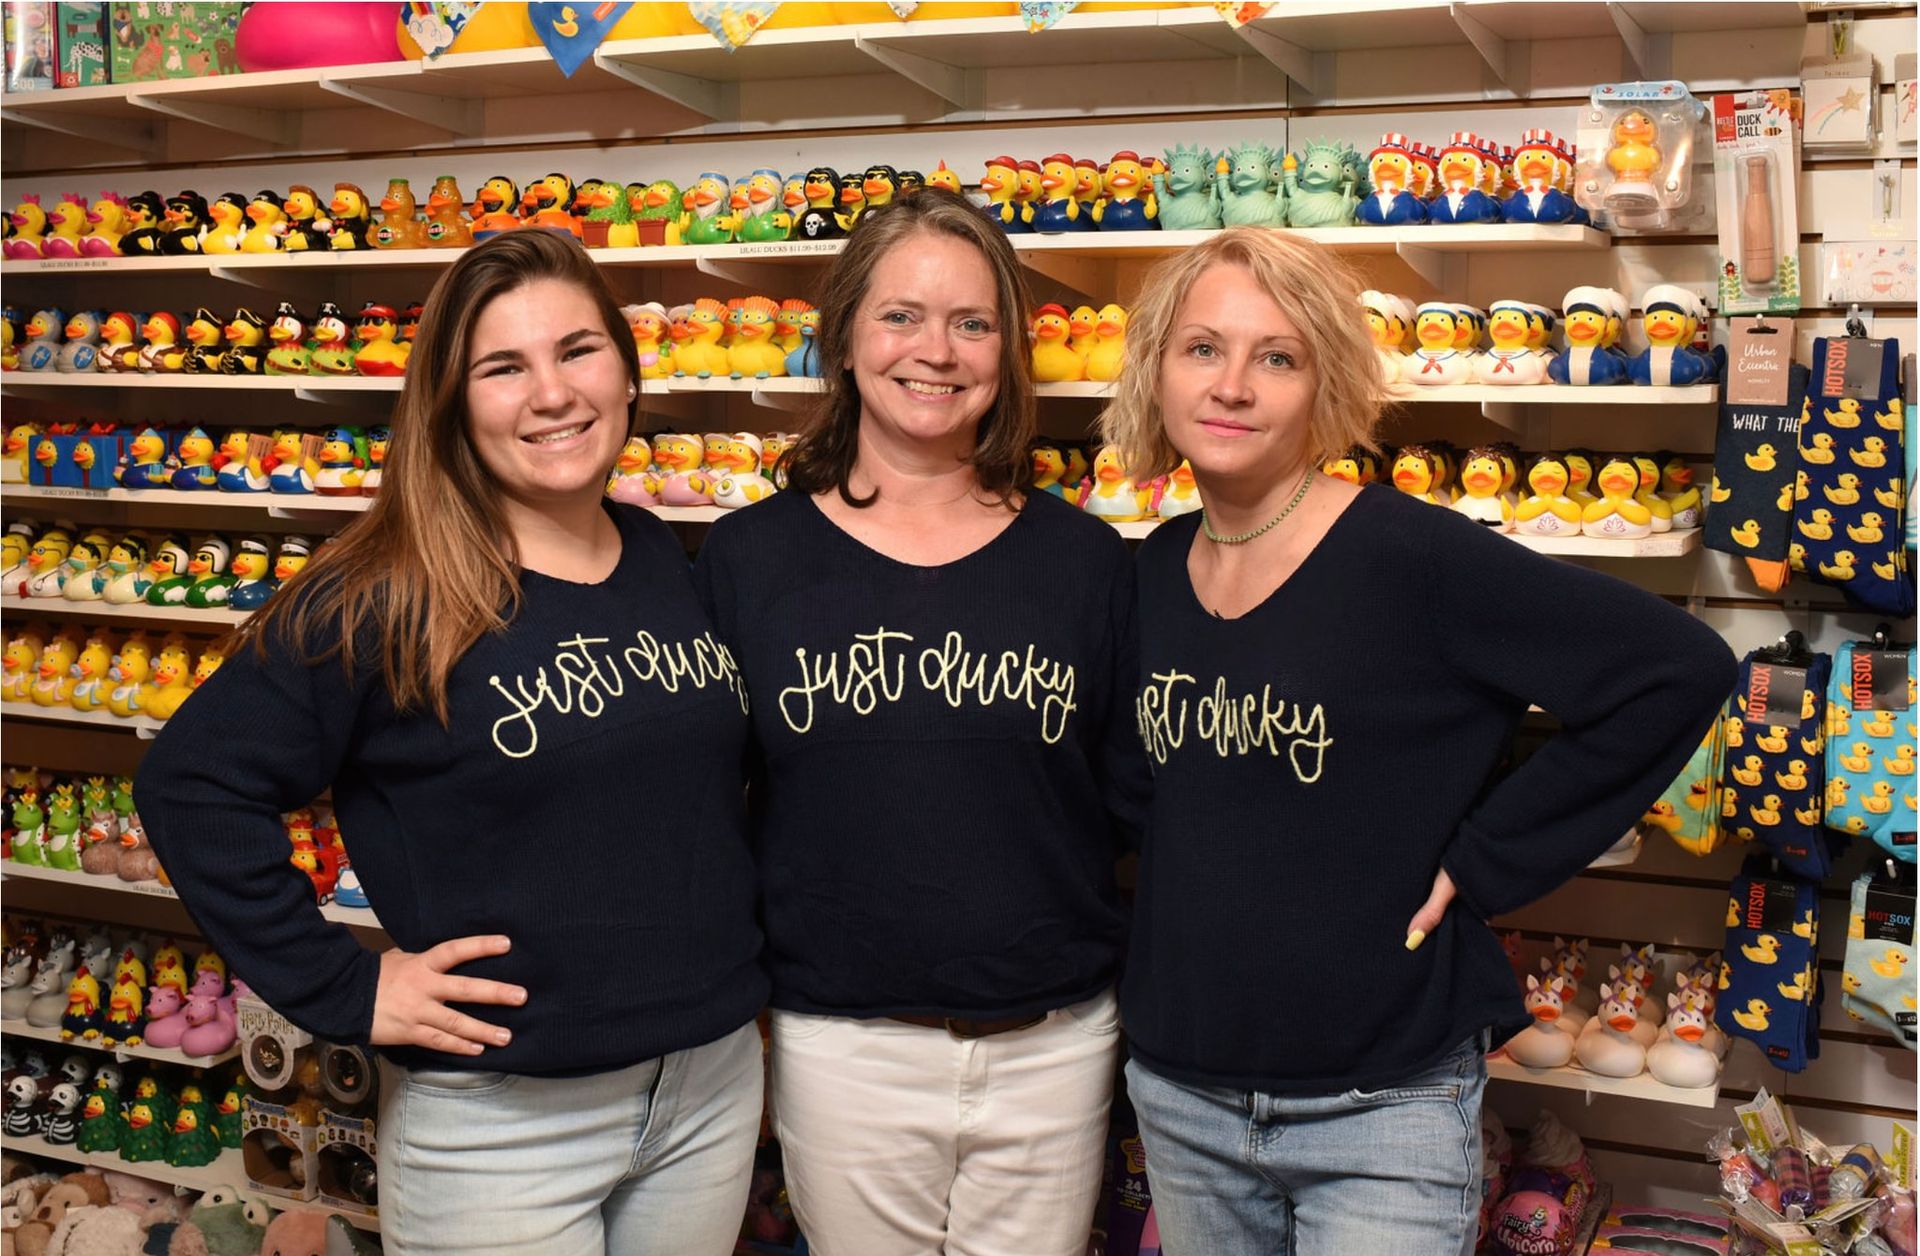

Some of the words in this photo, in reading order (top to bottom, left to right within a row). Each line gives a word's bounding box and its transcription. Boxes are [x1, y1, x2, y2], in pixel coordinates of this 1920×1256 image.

[1617, 90, 1660, 98] SOLAR
[1737, 114, 1762, 126] DUCK
[1738, 126, 1761, 138] CALL
[763, 245, 788, 254] DUCKS
[1744, 343, 1777, 357] Urban
[1824, 341, 1849, 396] HOTSOX
[1732, 413, 1769, 432] WHAT
[1777, 416, 1800, 433] THE
[489, 633, 624, 758] just
[779, 626, 914, 733] just
[918, 631, 1077, 744] ducky
[1746, 665, 1772, 723] HOTSOX
[1853, 652, 1872, 710] HOTSOX
[1135, 668, 1196, 776] ust
[1197, 675, 1334, 783] ducky
[1746, 882, 1766, 929] HOTSOX
[1504, 1213, 1530, 1233] Fairy
